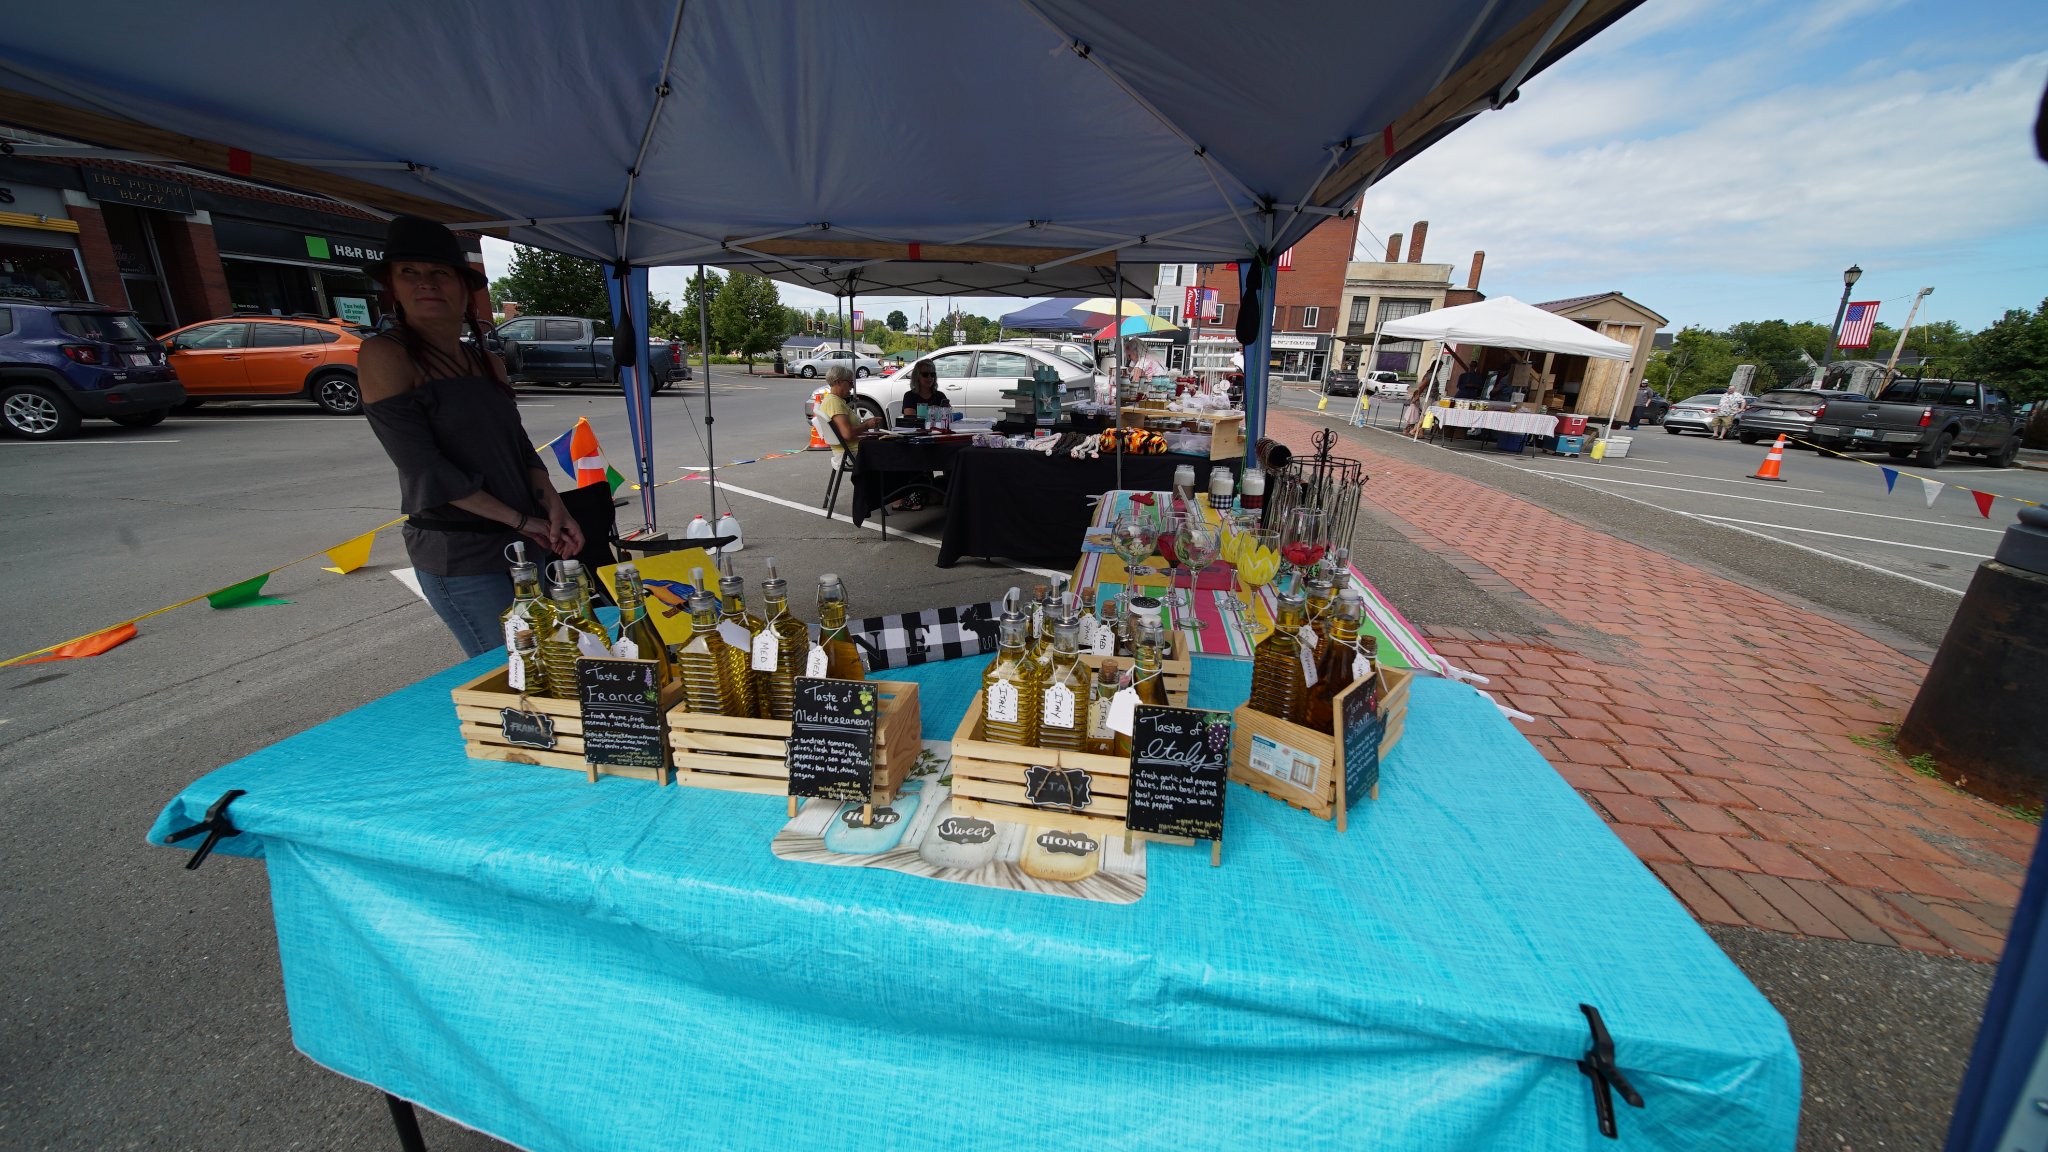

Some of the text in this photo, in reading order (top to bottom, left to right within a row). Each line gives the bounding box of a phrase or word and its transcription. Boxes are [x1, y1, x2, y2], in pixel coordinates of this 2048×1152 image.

[93, 173, 185, 198] THE PUTNAM
[120, 189, 165, 205] BLOCK
[334, 244, 364, 259] H&R
[585, 666, 636, 681] Taste of
[804, 684, 852, 702] Taste of
[824, 702, 839, 711] the
[996, 687, 1008, 716] ITALY
[1140, 713, 1203, 735] Taste of
[1160, 783, 1177, 791] fresh
[1183, 776, 1193, 784] red
[939, 820, 991, 838] Sweet
[1040, 834, 1096, 851] HOME
